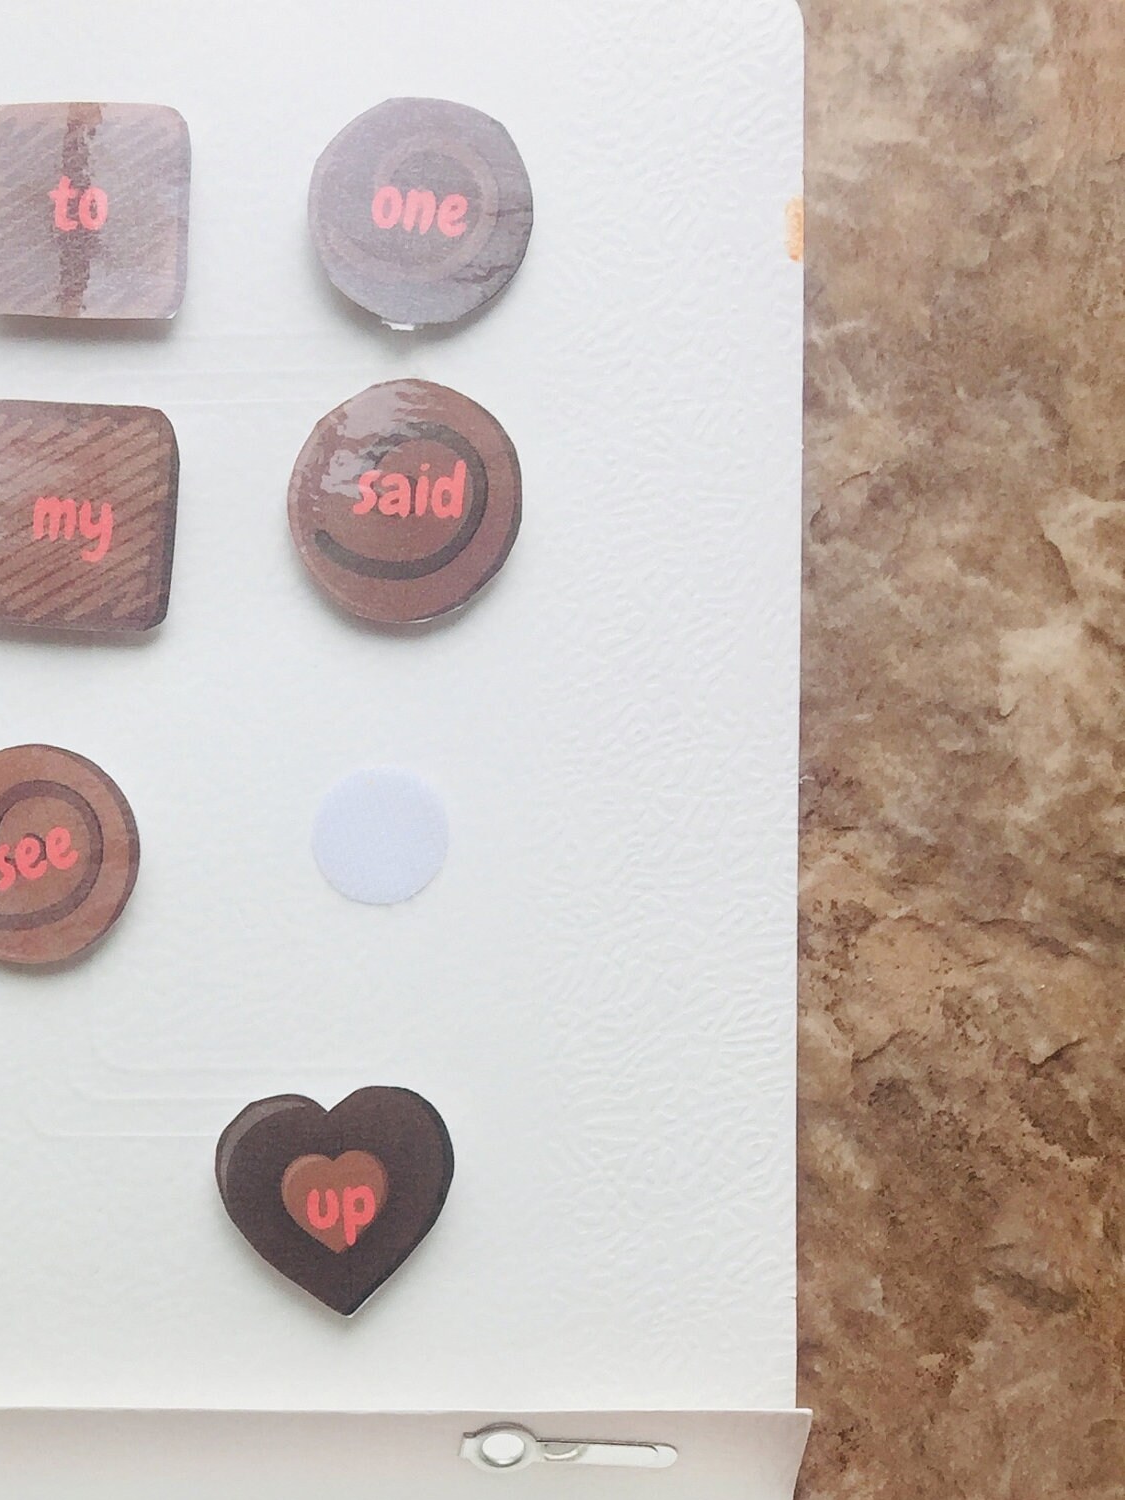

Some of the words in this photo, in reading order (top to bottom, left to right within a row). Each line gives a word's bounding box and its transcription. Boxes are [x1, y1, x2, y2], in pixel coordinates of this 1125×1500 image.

[50, 176, 107, 233] to
[372, 185, 468, 237] one
[353, 460, 466, 519] said
[33, 496, 113, 562] my
[306, 1184, 376, 1244] up
